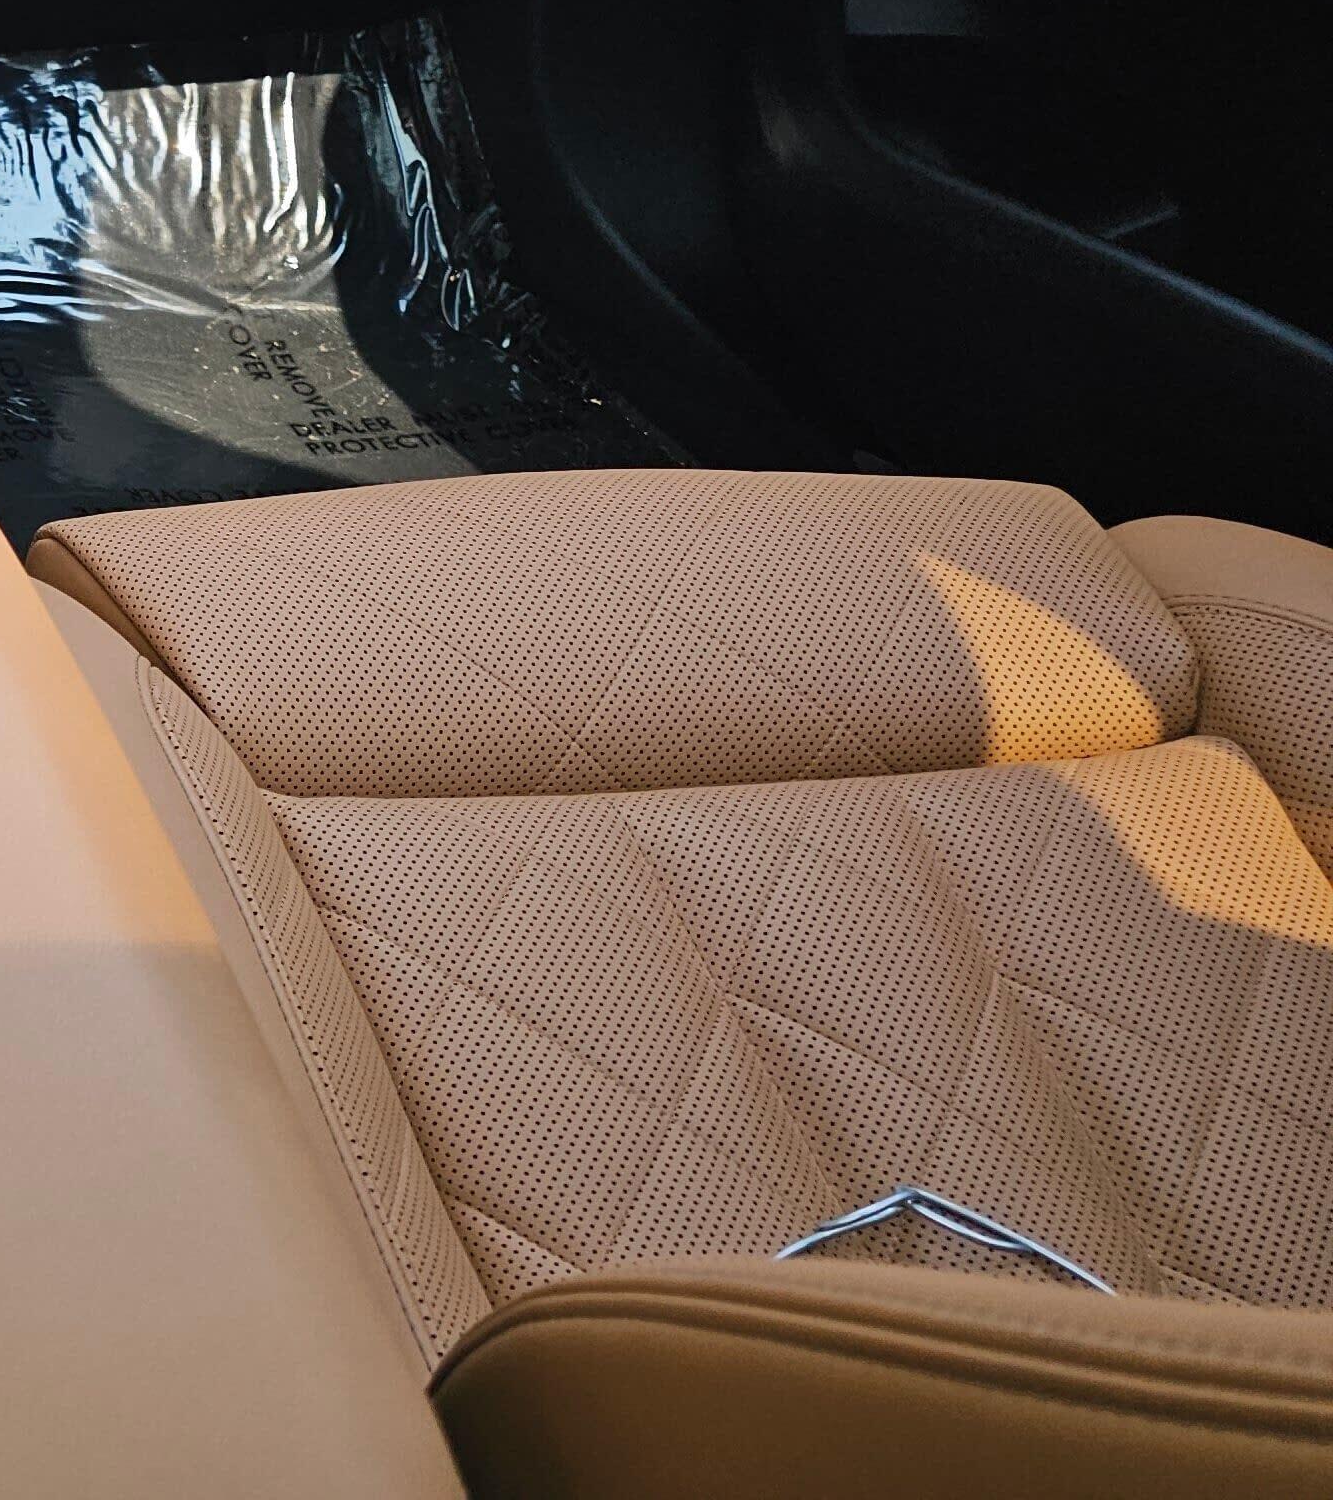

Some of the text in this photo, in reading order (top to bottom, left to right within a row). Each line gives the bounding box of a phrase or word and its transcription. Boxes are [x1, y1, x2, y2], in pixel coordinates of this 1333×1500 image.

[264, 339, 337, 420] REMOVE
[290, 416, 398, 439] DEALER
[304, 430, 471, 458] PROTECTIVE
